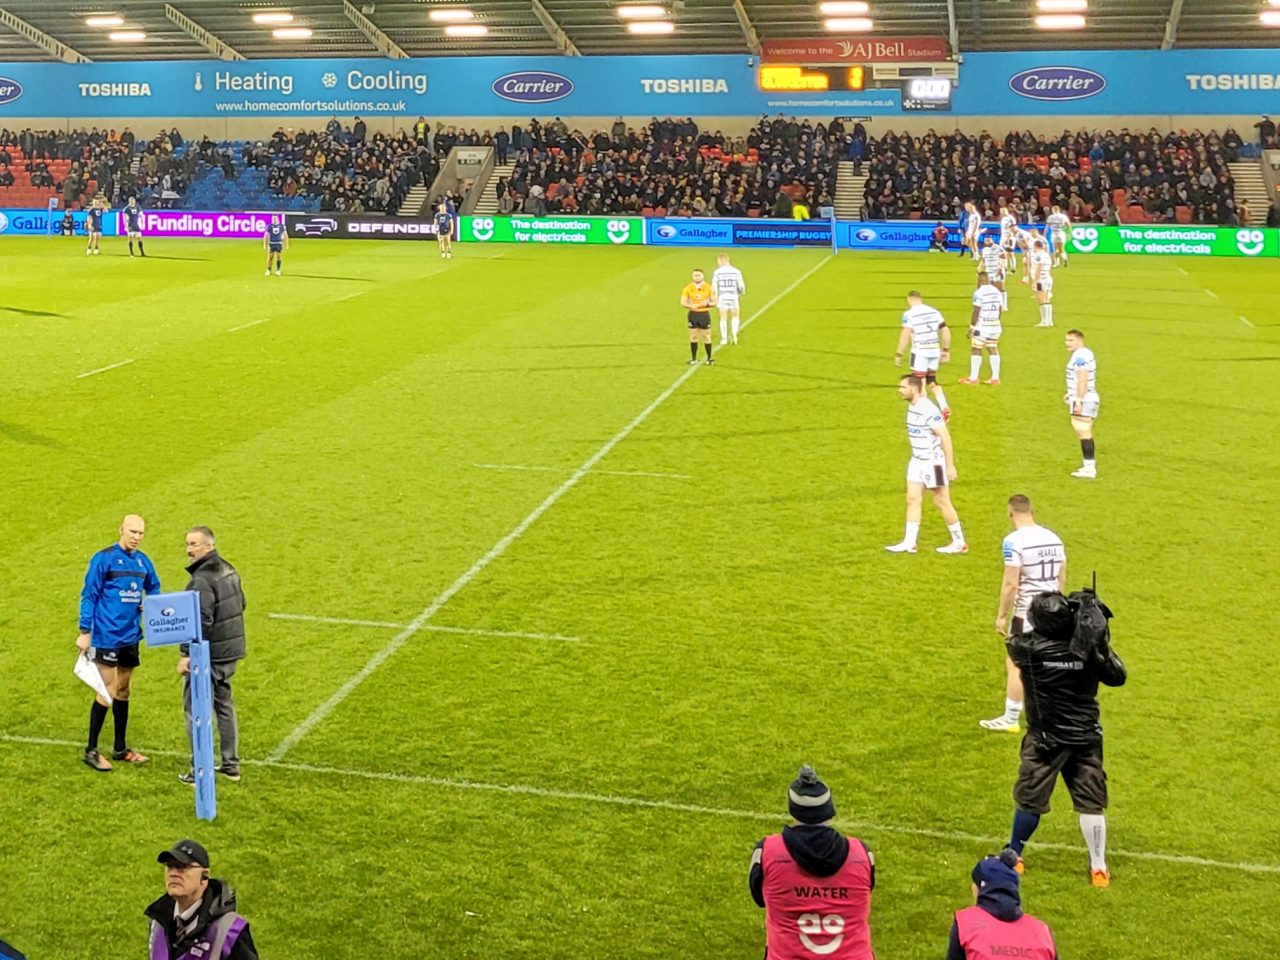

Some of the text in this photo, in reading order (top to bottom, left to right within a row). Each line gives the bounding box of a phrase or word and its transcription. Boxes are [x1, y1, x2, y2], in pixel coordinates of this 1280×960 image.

[767, 43, 942, 59] Welcome to the AJ Bell Stadium
[214, 72, 294, 95] Heating
[346, 70, 428, 94] Cooling
[503, 79, 564, 93] Carrier
[640, 79, 729, 94] TOSHIBA
[1022, 75, 1095, 90] Carrier
[79, 83, 152, 97] TOSHIBA
[215, 100, 407, 112] www.homecomfortsolutions.co.uk
[12, 216, 87, 233] Gallager
[147, 214, 267, 235] Funding Circle
[511, 220, 590, 230] The destination
[514, 232, 586, 242] for electricals
[679, 227, 728, 239] Gallagher
[735, 229, 832, 240] PREMIERSHIP RUGBY
[1118, 229, 1216, 241] The destination
[1123, 243, 1211, 254] for electricals
[1038, 558, 1057, 582] 11
[149, 616, 189, 627] Gallagher
[153, 625, 186, 634] INSURANCE
[793, 885, 849, 900] WATER
[989, 944, 1033, 960] MEDIC
